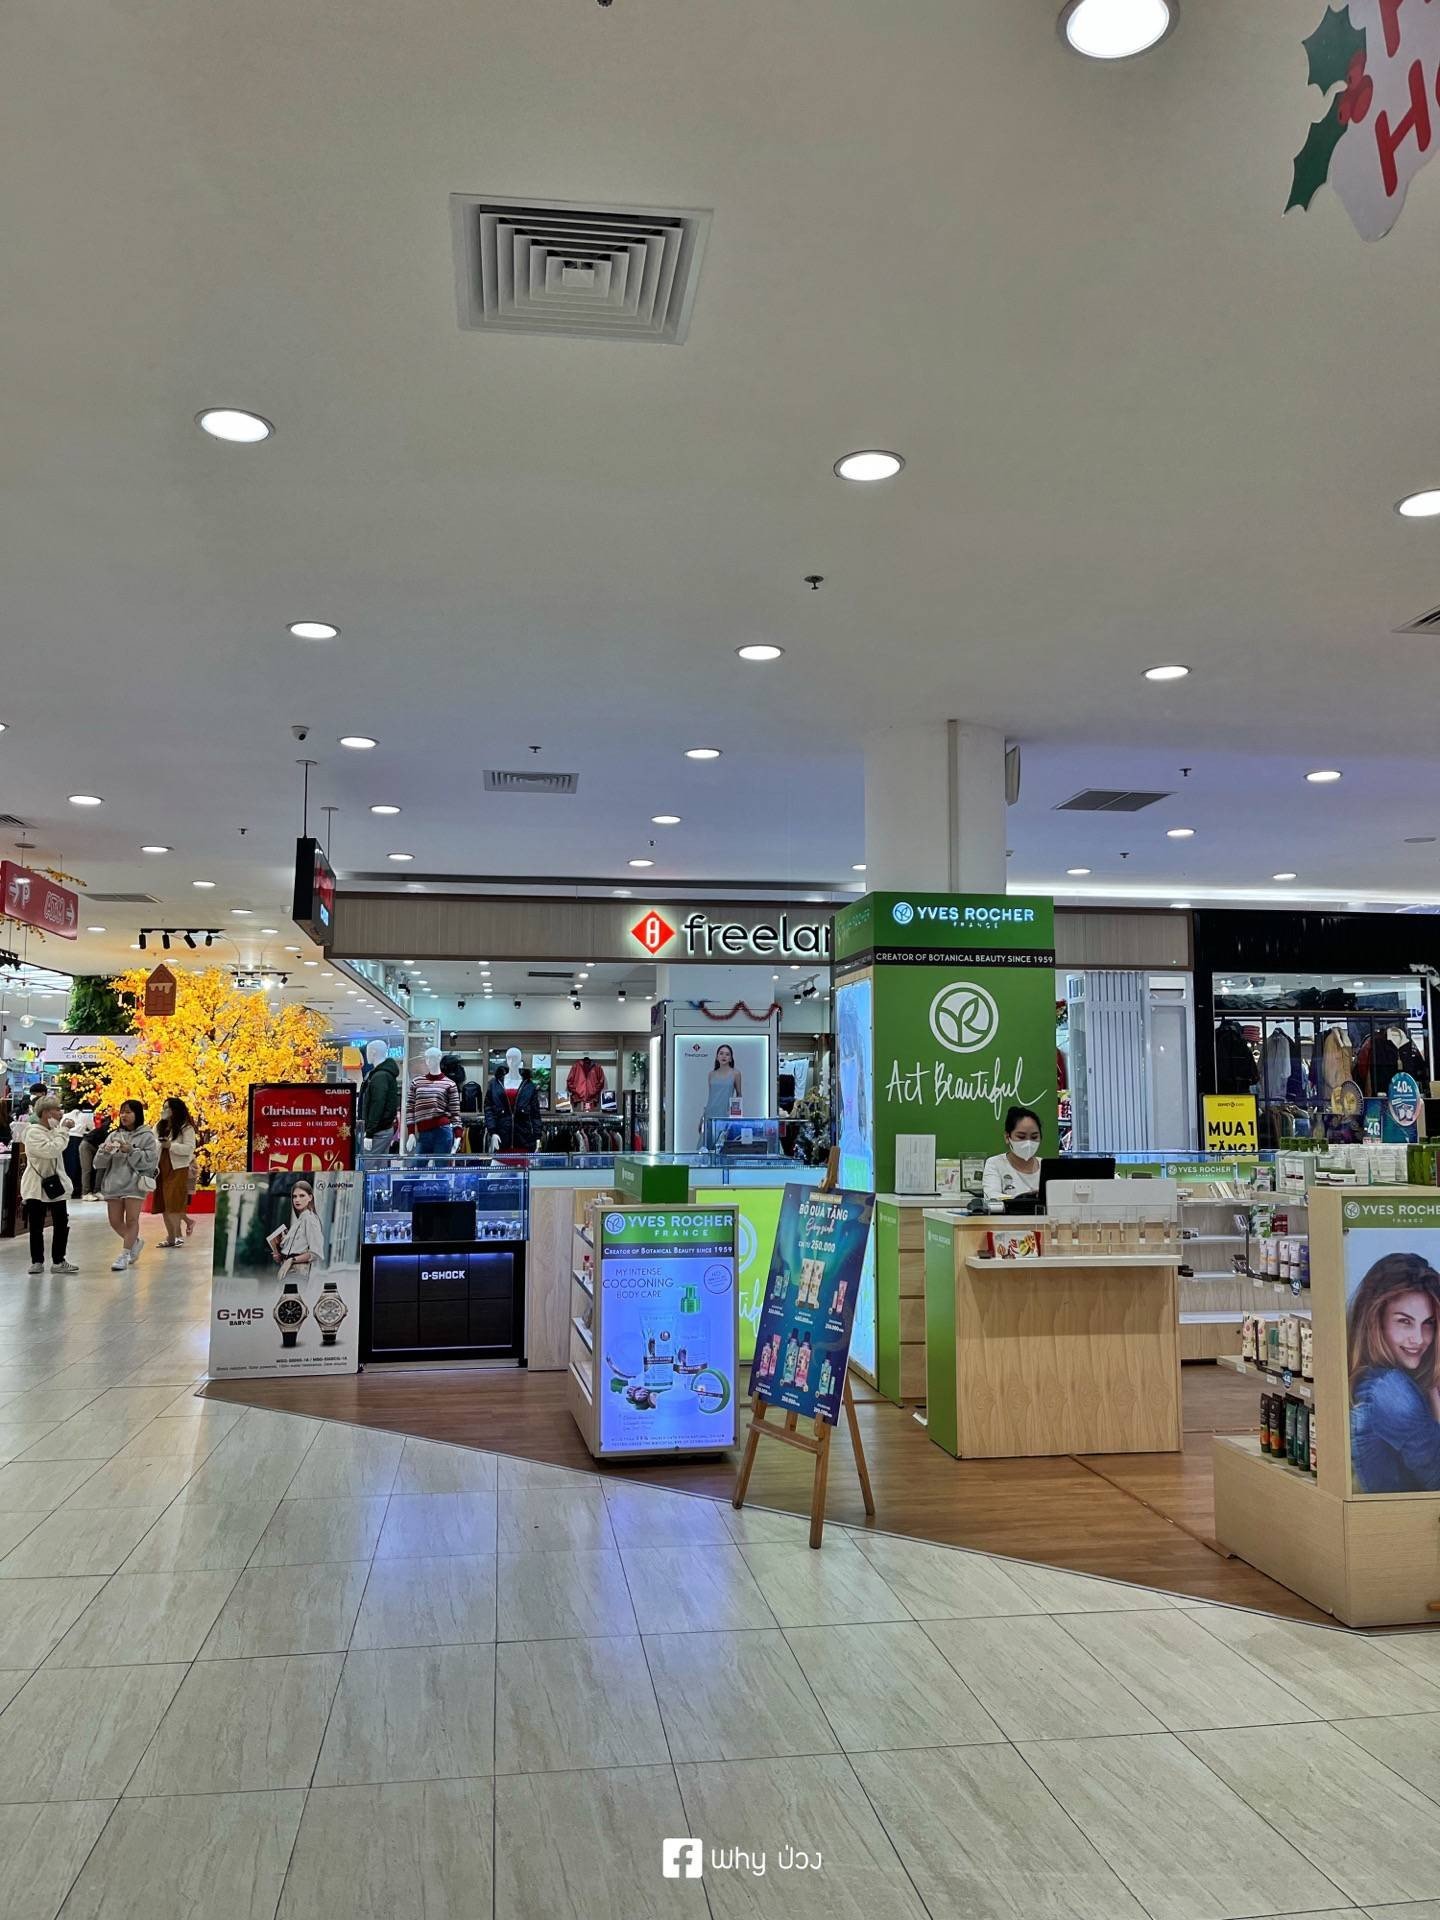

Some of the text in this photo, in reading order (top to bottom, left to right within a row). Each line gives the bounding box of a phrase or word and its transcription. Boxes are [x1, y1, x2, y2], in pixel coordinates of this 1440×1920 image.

[917, 906, 1034, 922] YVES ROCHER
[683, 913, 830, 953] freela
[876, 953, 914, 961] CREATOR
[915, 953, 927, 961] OF
[929, 954, 974, 962] BOTANICAL
[976, 954, 1006, 963] BEAUTY
[1008, 955, 1031, 963] SINCE
[885, 1056, 1047, 1120] Act Beautiful
[261, 1104, 348, 1117] Christmas Party
[1208, 1121, 1255, 1136] MUA 1
[274, 1137, 335, 1146] SALE UP TO
[220, 1183, 256, 1192] CASIO
[1362, 1205, 1440, 1215] YVES ROCHE
[628, 1215, 733, 1227] YVES ROCHER
[641, 1247, 672, 1255] BOTANICAL
[673, 1246, 695, 1254] BEAUTY
[421, 1270, 466, 1280] G-SHOCK
[615, 1267, 662, 1276] MY INTENSE
[602, 1278, 674, 1289] COCOONING
[616, 1290, 662, 1299] BODY CARE
[217, 1308, 264, 1320] G-MS
